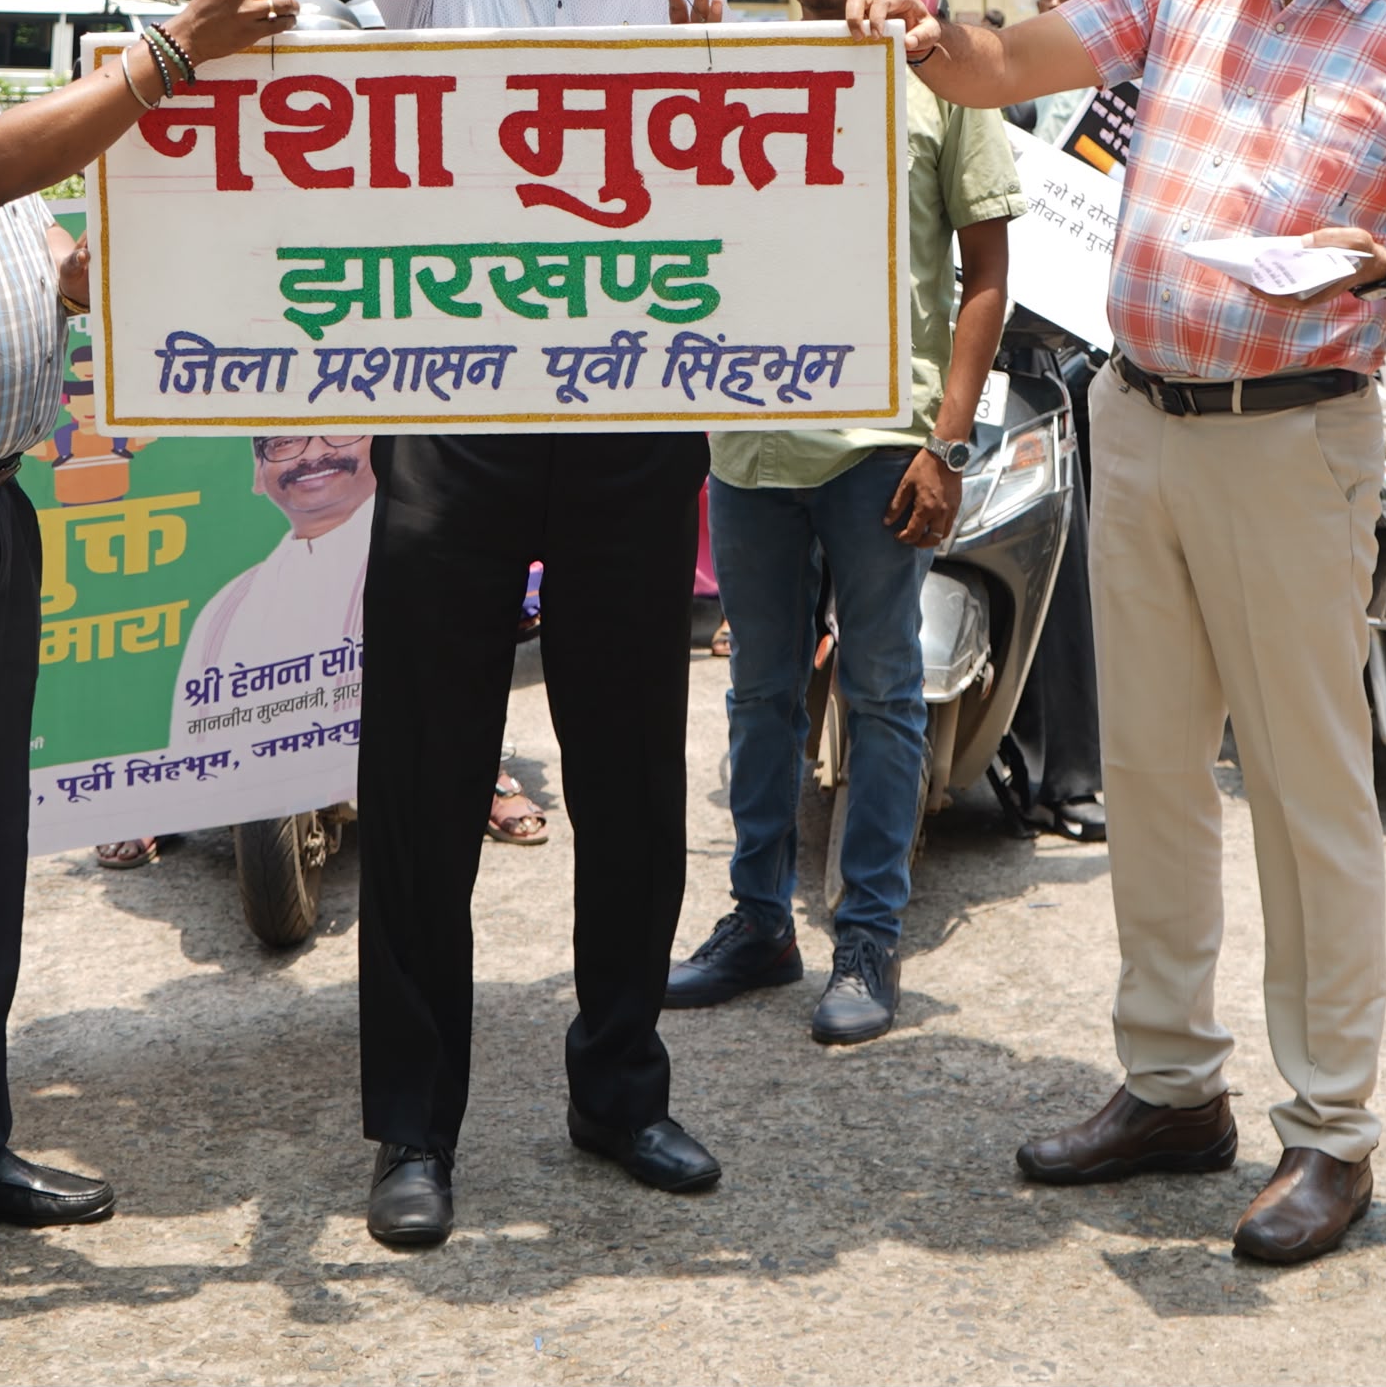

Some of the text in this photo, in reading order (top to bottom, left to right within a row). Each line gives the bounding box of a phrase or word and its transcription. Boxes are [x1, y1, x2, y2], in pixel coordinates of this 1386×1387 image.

[138, 70, 855, 229] नशा मुक्त
[1027, 197, 1067, 228] जीवन
[1069, 220, 1084, 238] से
[1043, 179, 1069, 201] नशे
[1071, 193, 1085, 210] से
[276, 239, 723, 341] झारखण्ड
[154, 330, 855, 405] जिला प्रशासन पूर्वी सिंहभूम
[38, 599, 190, 665] मारा
[184, 667, 224, 707] श्री
[229, 662, 314, 699] हेमन्त
[188, 706, 253, 735] माननीय
[332, 681, 363, 703] झार
[57, 762, 115, 802] पूर्वी
[251, 718, 361, 758] जमशेदपु
